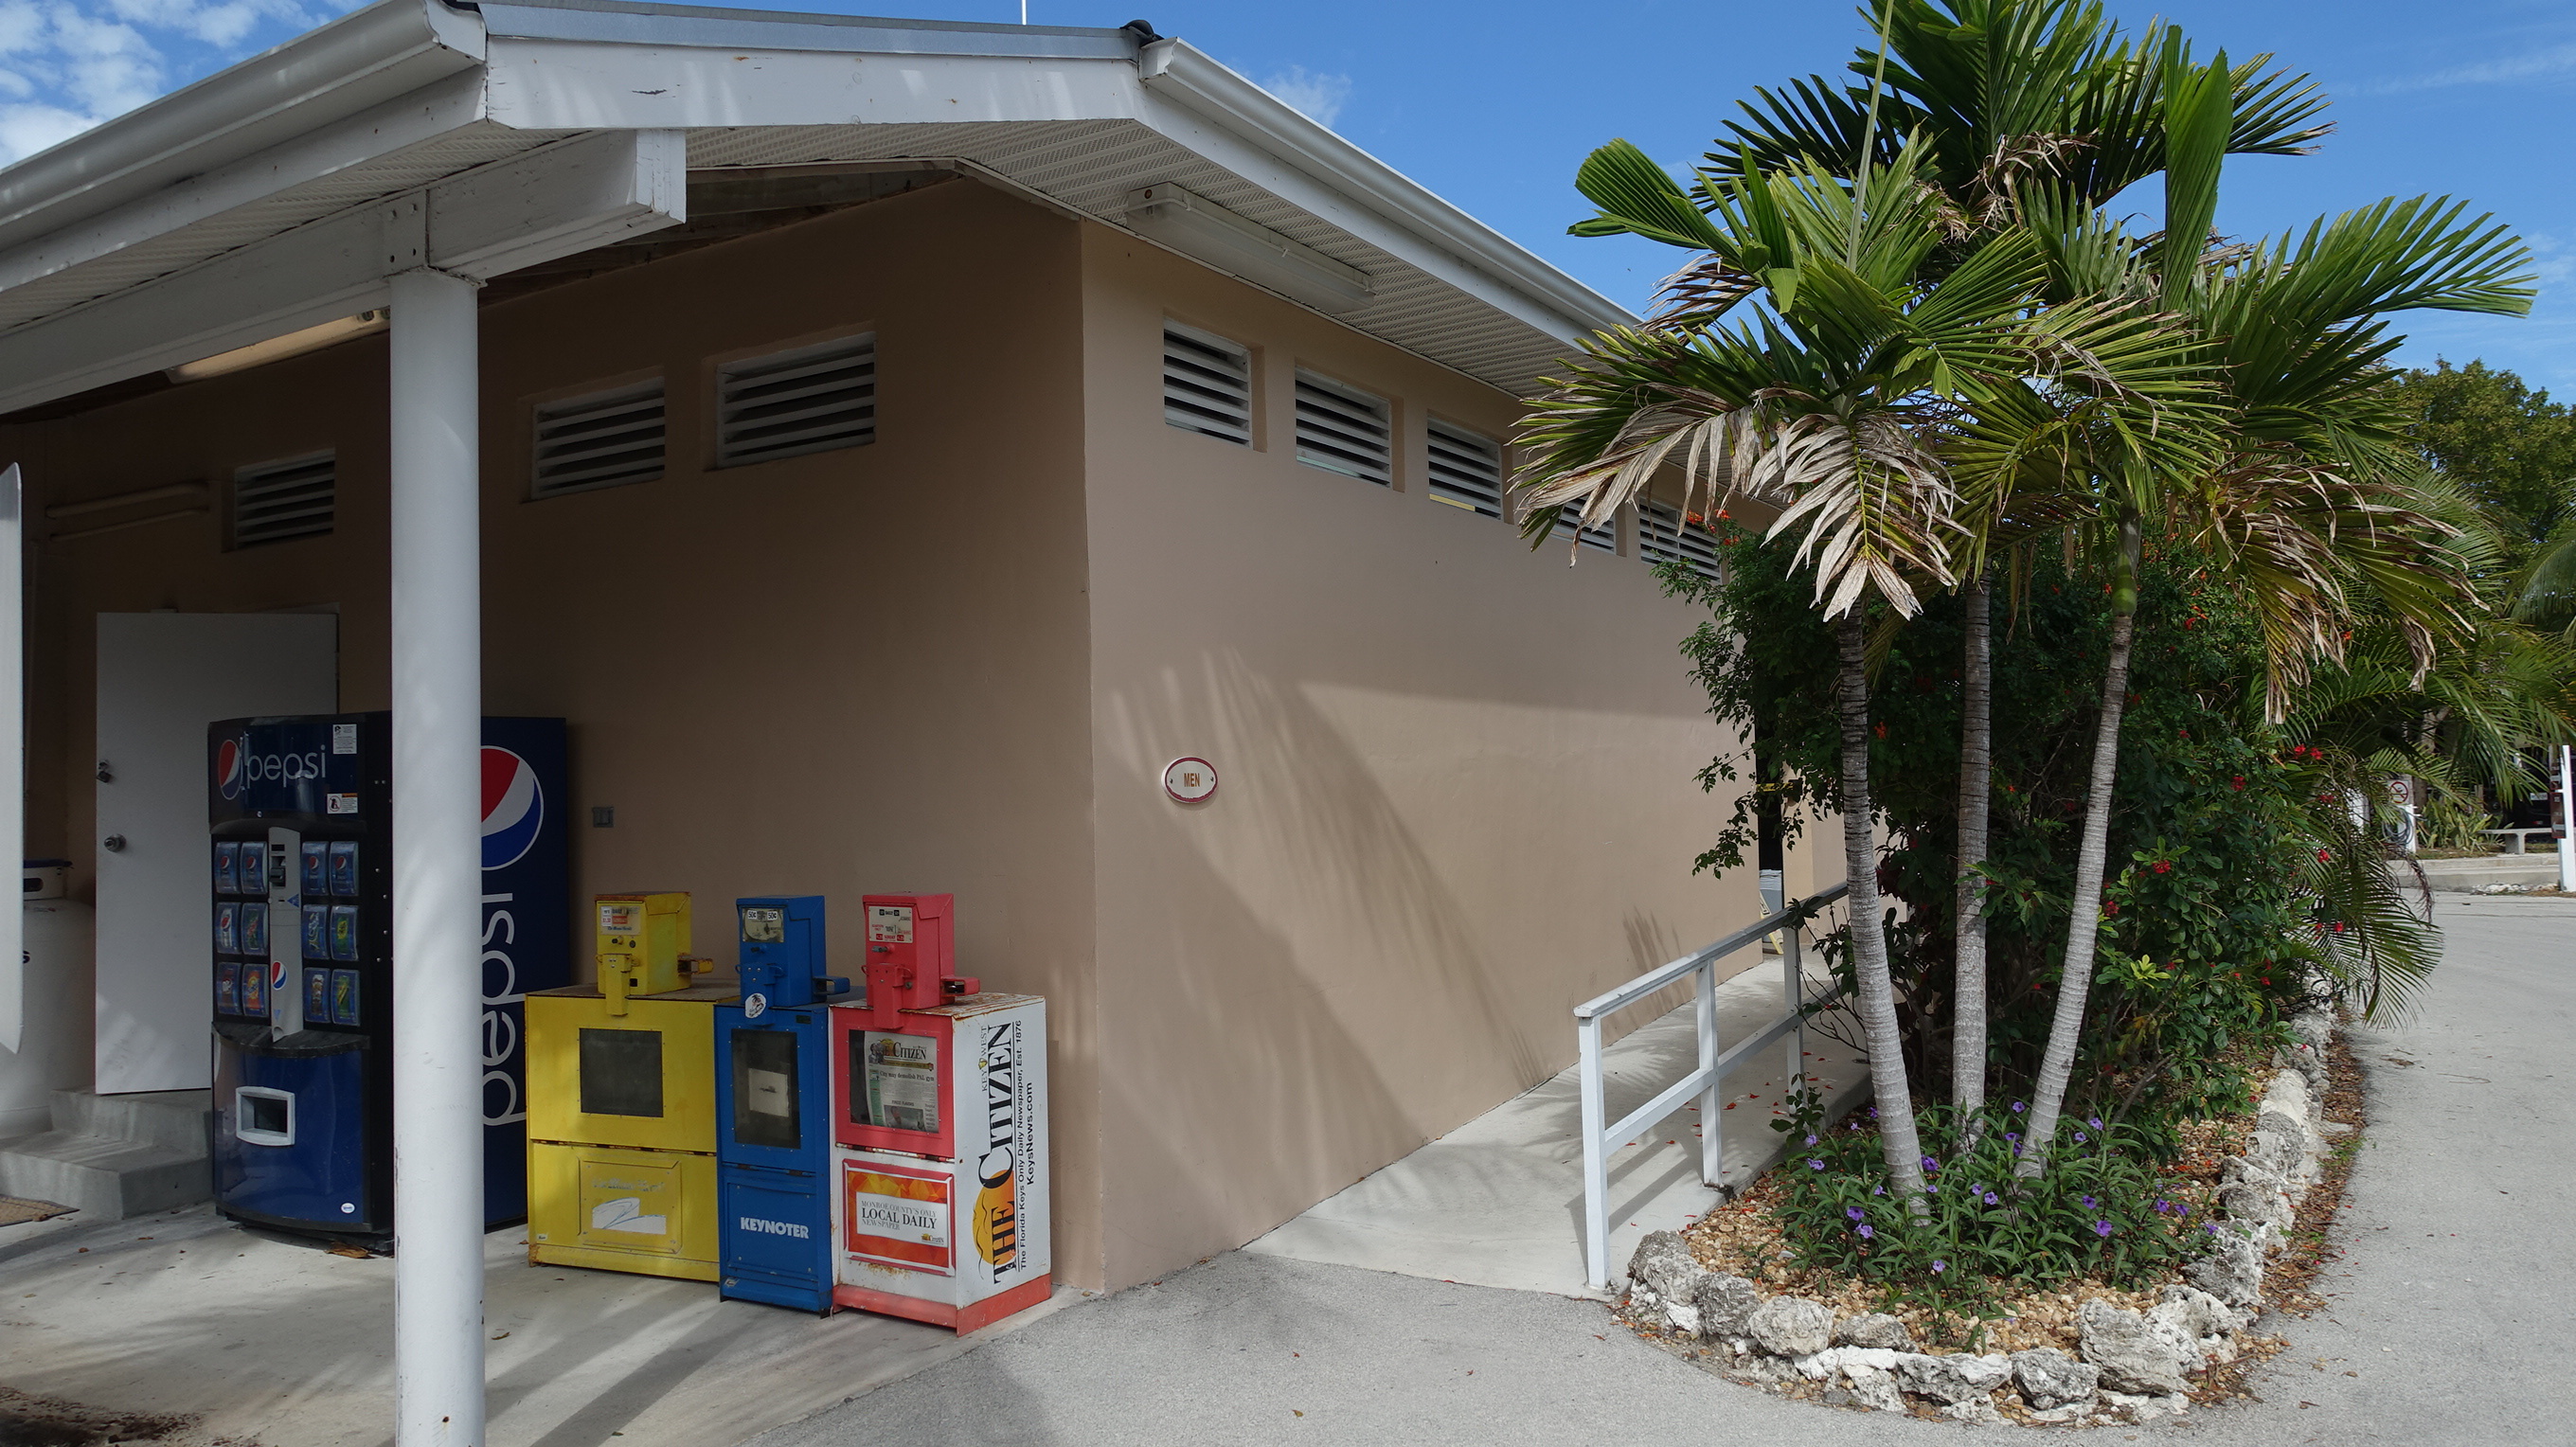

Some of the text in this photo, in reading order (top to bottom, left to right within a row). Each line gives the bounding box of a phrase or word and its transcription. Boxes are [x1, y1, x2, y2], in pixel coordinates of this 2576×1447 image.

[247, 744, 326, 788] pepsi
[1184, 773, 1200, 787] MEN
[482, 893, 527, 1126] pepsi
[893, 1042, 927, 1060] CITIZEN
[1026, 1081, 1035, 1186] KeysNews.com
[978, 1023, 1017, 1285] THE CITIZEN
[861, 1200, 937, 1218] MONROE COUNTY'S ONLY
[862, 1207, 937, 1229] LOCAL DAILY
[741, 1217, 809, 1240] KEYNOTER
[862, 1219, 901, 1230] NEWSPAPER
